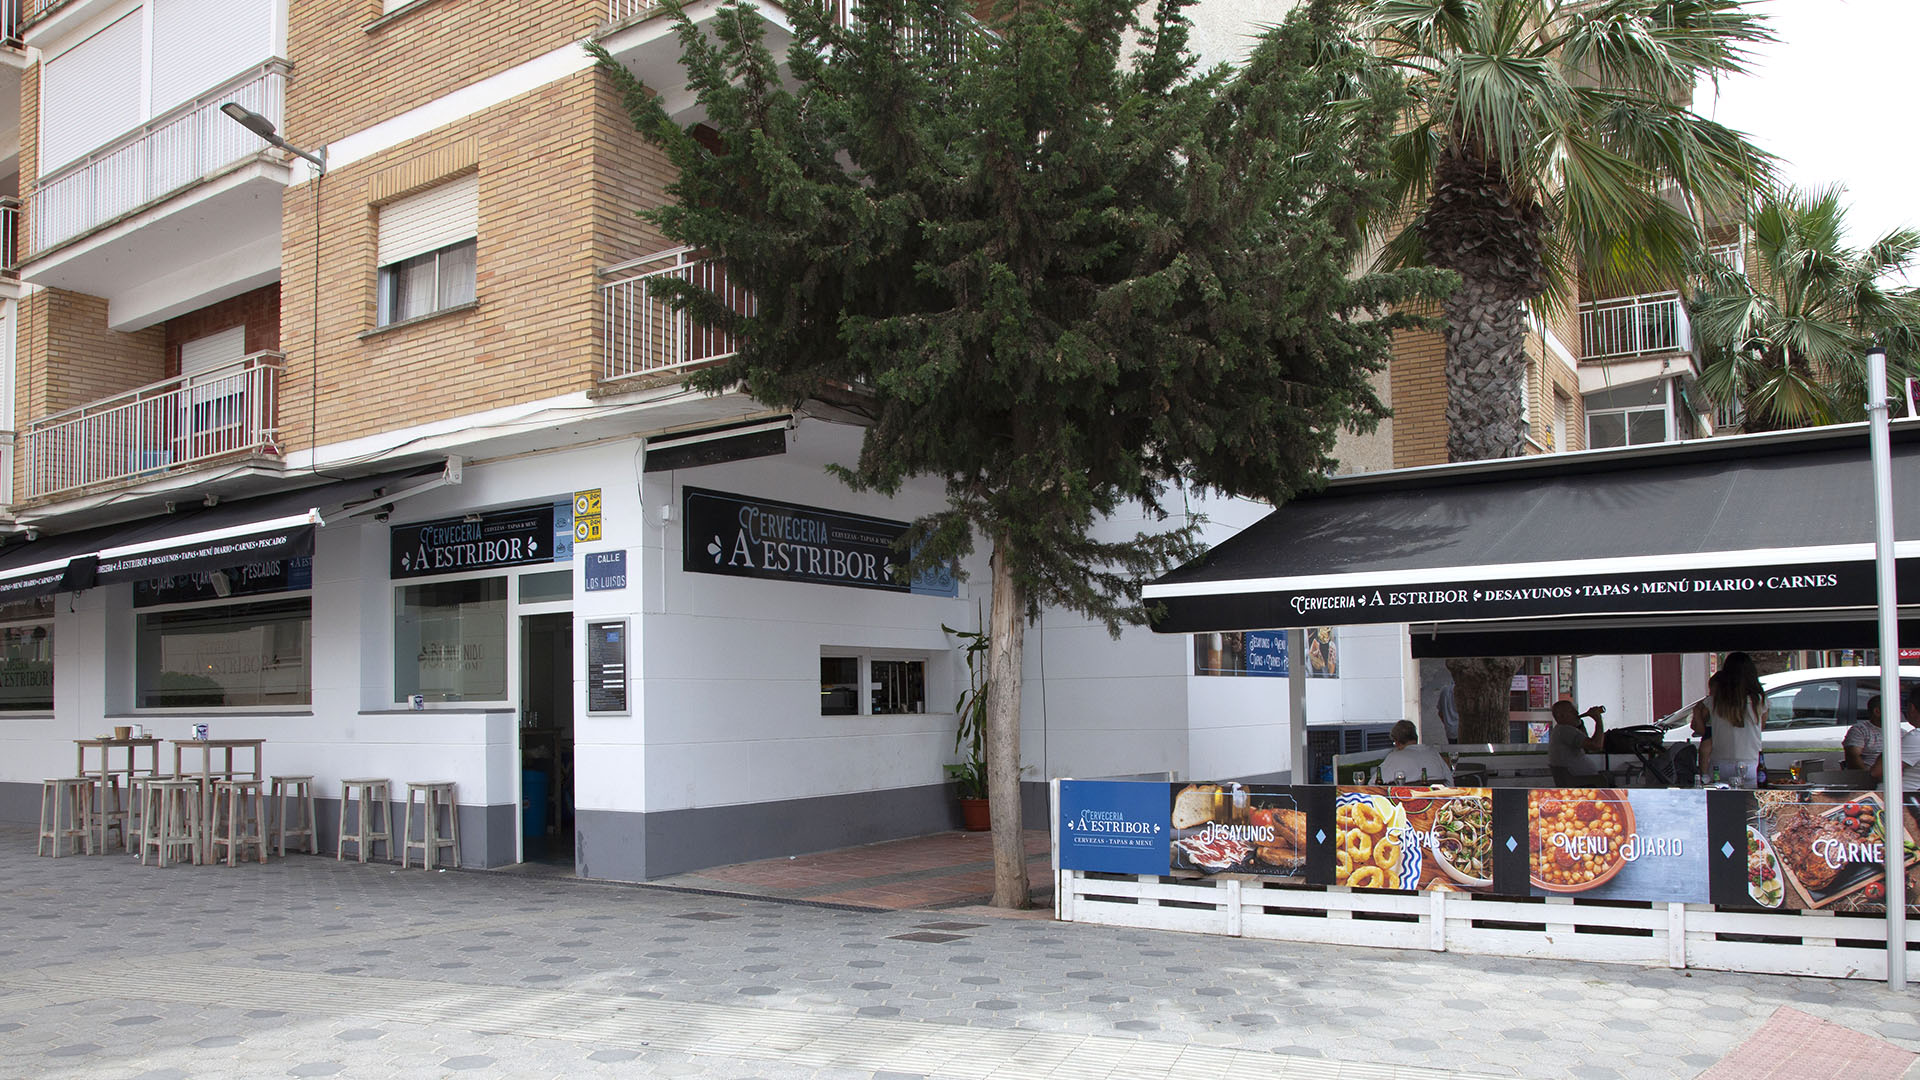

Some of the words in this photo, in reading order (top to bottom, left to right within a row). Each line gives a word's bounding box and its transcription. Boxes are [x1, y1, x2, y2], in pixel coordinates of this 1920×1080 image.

[420, 523, 481, 552] CERVECERIA
[739, 506, 828, 545] CERVECERIA
[122, 557, 147, 569] ESTRIBOR
[152, 553, 179, 565] DESAYUNOS
[181, 550, 196, 560] TAPAS
[214, 545, 232, 555] DIARIO
[234, 540, 255, 551] CARNES
[258, 536, 287, 548] PESCADOS
[414, 544, 430, 570] A
[435, 538, 522, 568] ESTRIBOR
[597, 553, 620, 564] CALLE
[728, 528, 755, 567] A
[762, 541, 878, 581] ESTRIBOR
[242, 560, 280, 585] PESCADOS
[586, 578, 599, 590] LOS
[601, 575, 626, 588] LUISOS
[1290, 595, 1356, 614] CERVECERIA
[1369, 590, 1385, 606] A
[1389, 590, 1469, 605] ESTRIBOR
[1484, 586, 1572, 601] DESAYUNOS
[1583, 583, 1630, 596] TAPAS
[1641, 577, 1690, 594] MENÚ
[1693, 578, 1754, 592] DIARIO
[1766, 574, 1838, 589] CARNES
[1077, 817, 1088, 831] A
[1091, 820, 1151, 834] ESTRIBOR
[1081, 809, 1124, 823] CERVECERIA
[1074, 836, 1105, 844] CERVEZAS
[1109, 838, 1128, 846] TAPAS
[1200, 821, 1275, 845] DESAYUNOS
[1386, 827, 1440, 852] TAPAS
[1553, 832, 1608, 860] MENU
[1619, 833, 1684, 861] DIARIO
[1812, 839, 1884, 869] CARNE
